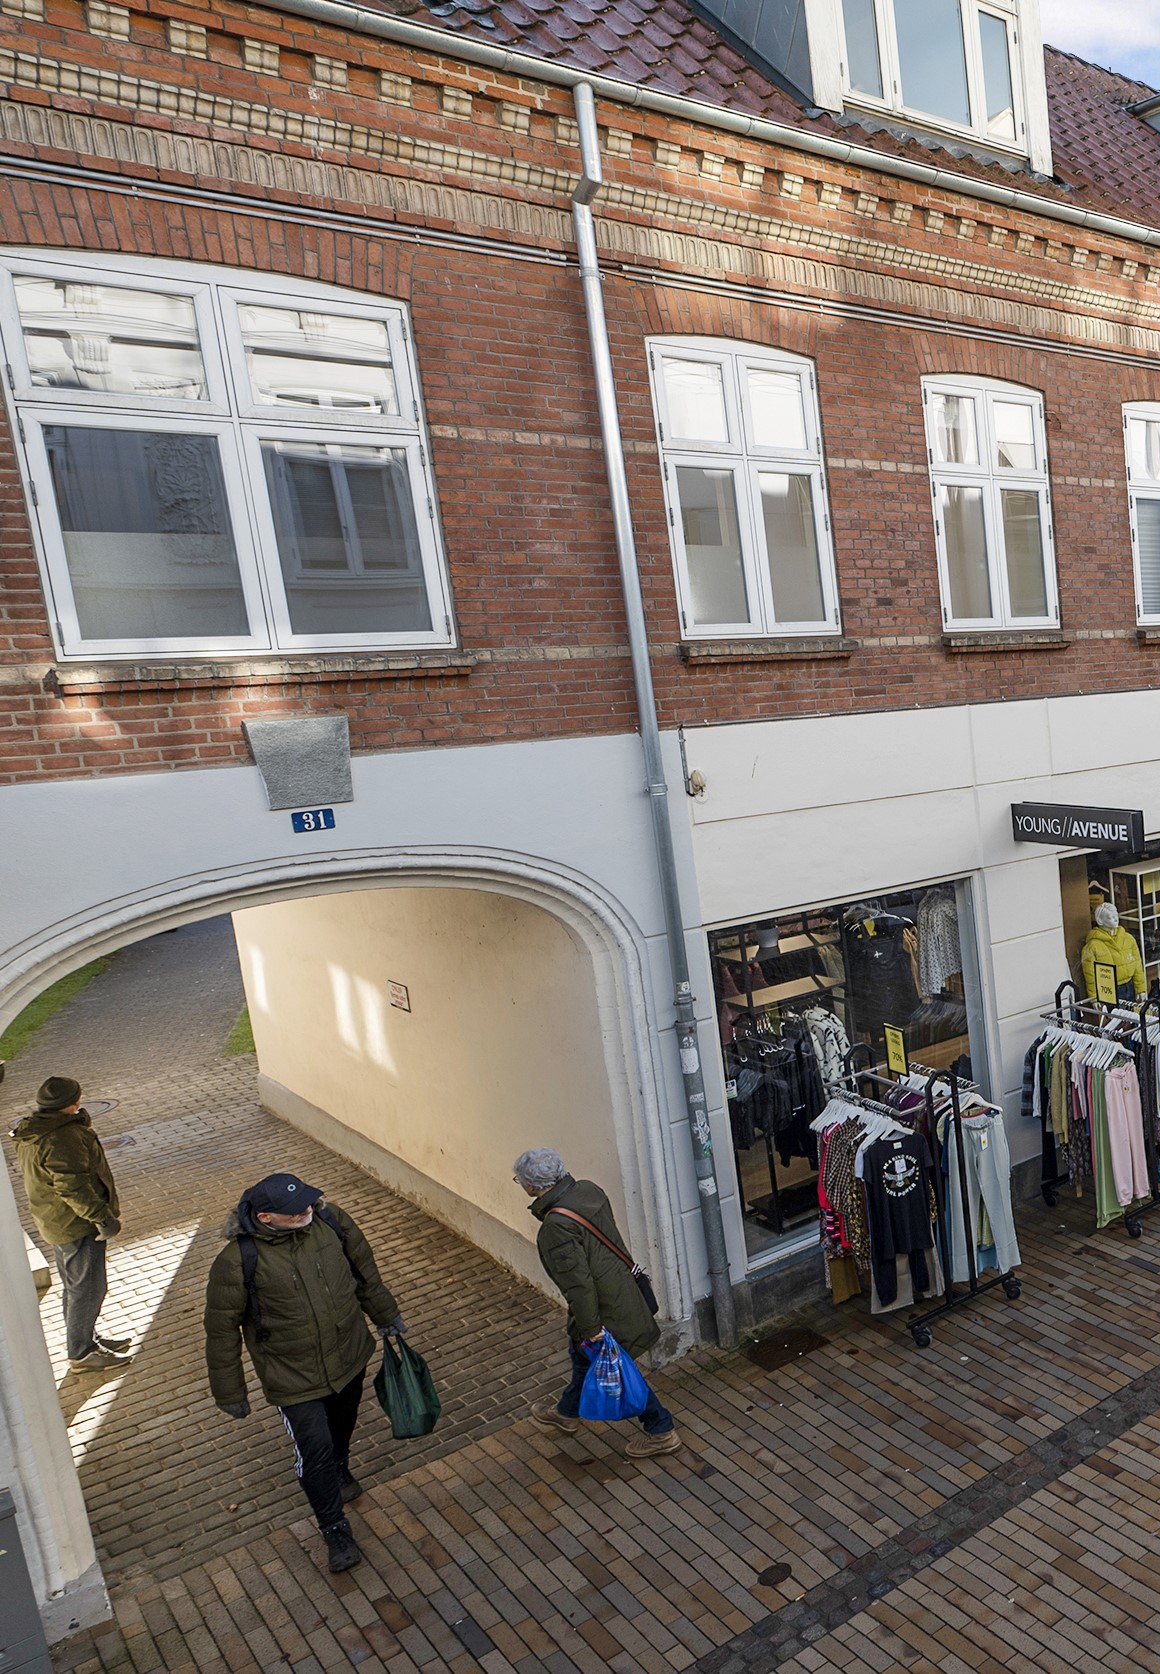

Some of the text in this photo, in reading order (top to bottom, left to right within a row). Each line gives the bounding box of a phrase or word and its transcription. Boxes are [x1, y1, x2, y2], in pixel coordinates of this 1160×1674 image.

[302, 811, 327, 830] 31
[1100, 985, 1112, 995] 70%
[892, 1051, 903, 1063] 70%
